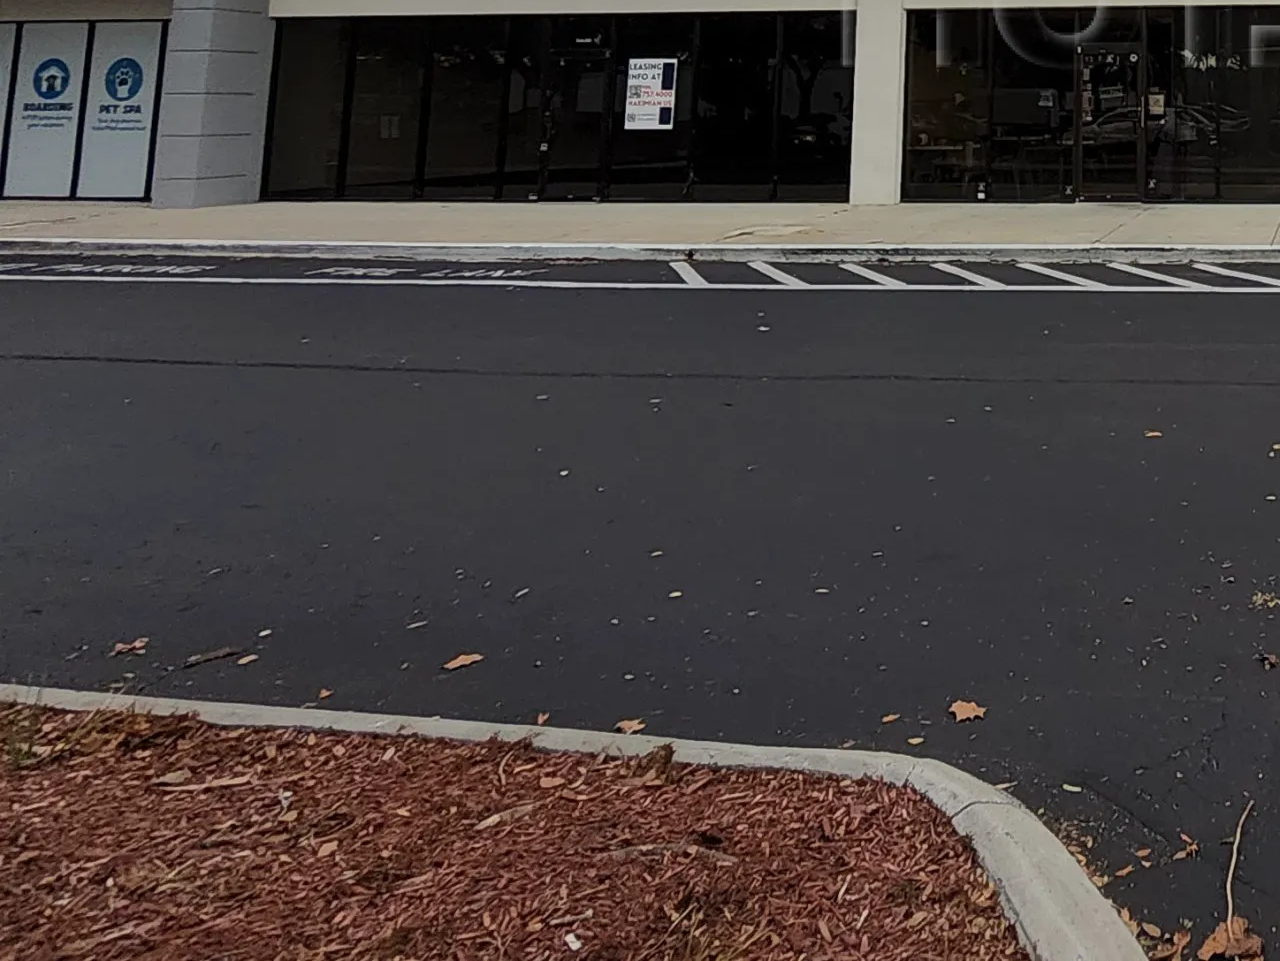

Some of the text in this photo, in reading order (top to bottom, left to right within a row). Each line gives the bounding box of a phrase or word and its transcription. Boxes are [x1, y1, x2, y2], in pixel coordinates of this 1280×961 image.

[629, 62, 662, 70] LEASING
[628, 72, 649, 80] INFO
[98, 104, 142, 114] PET SPA
